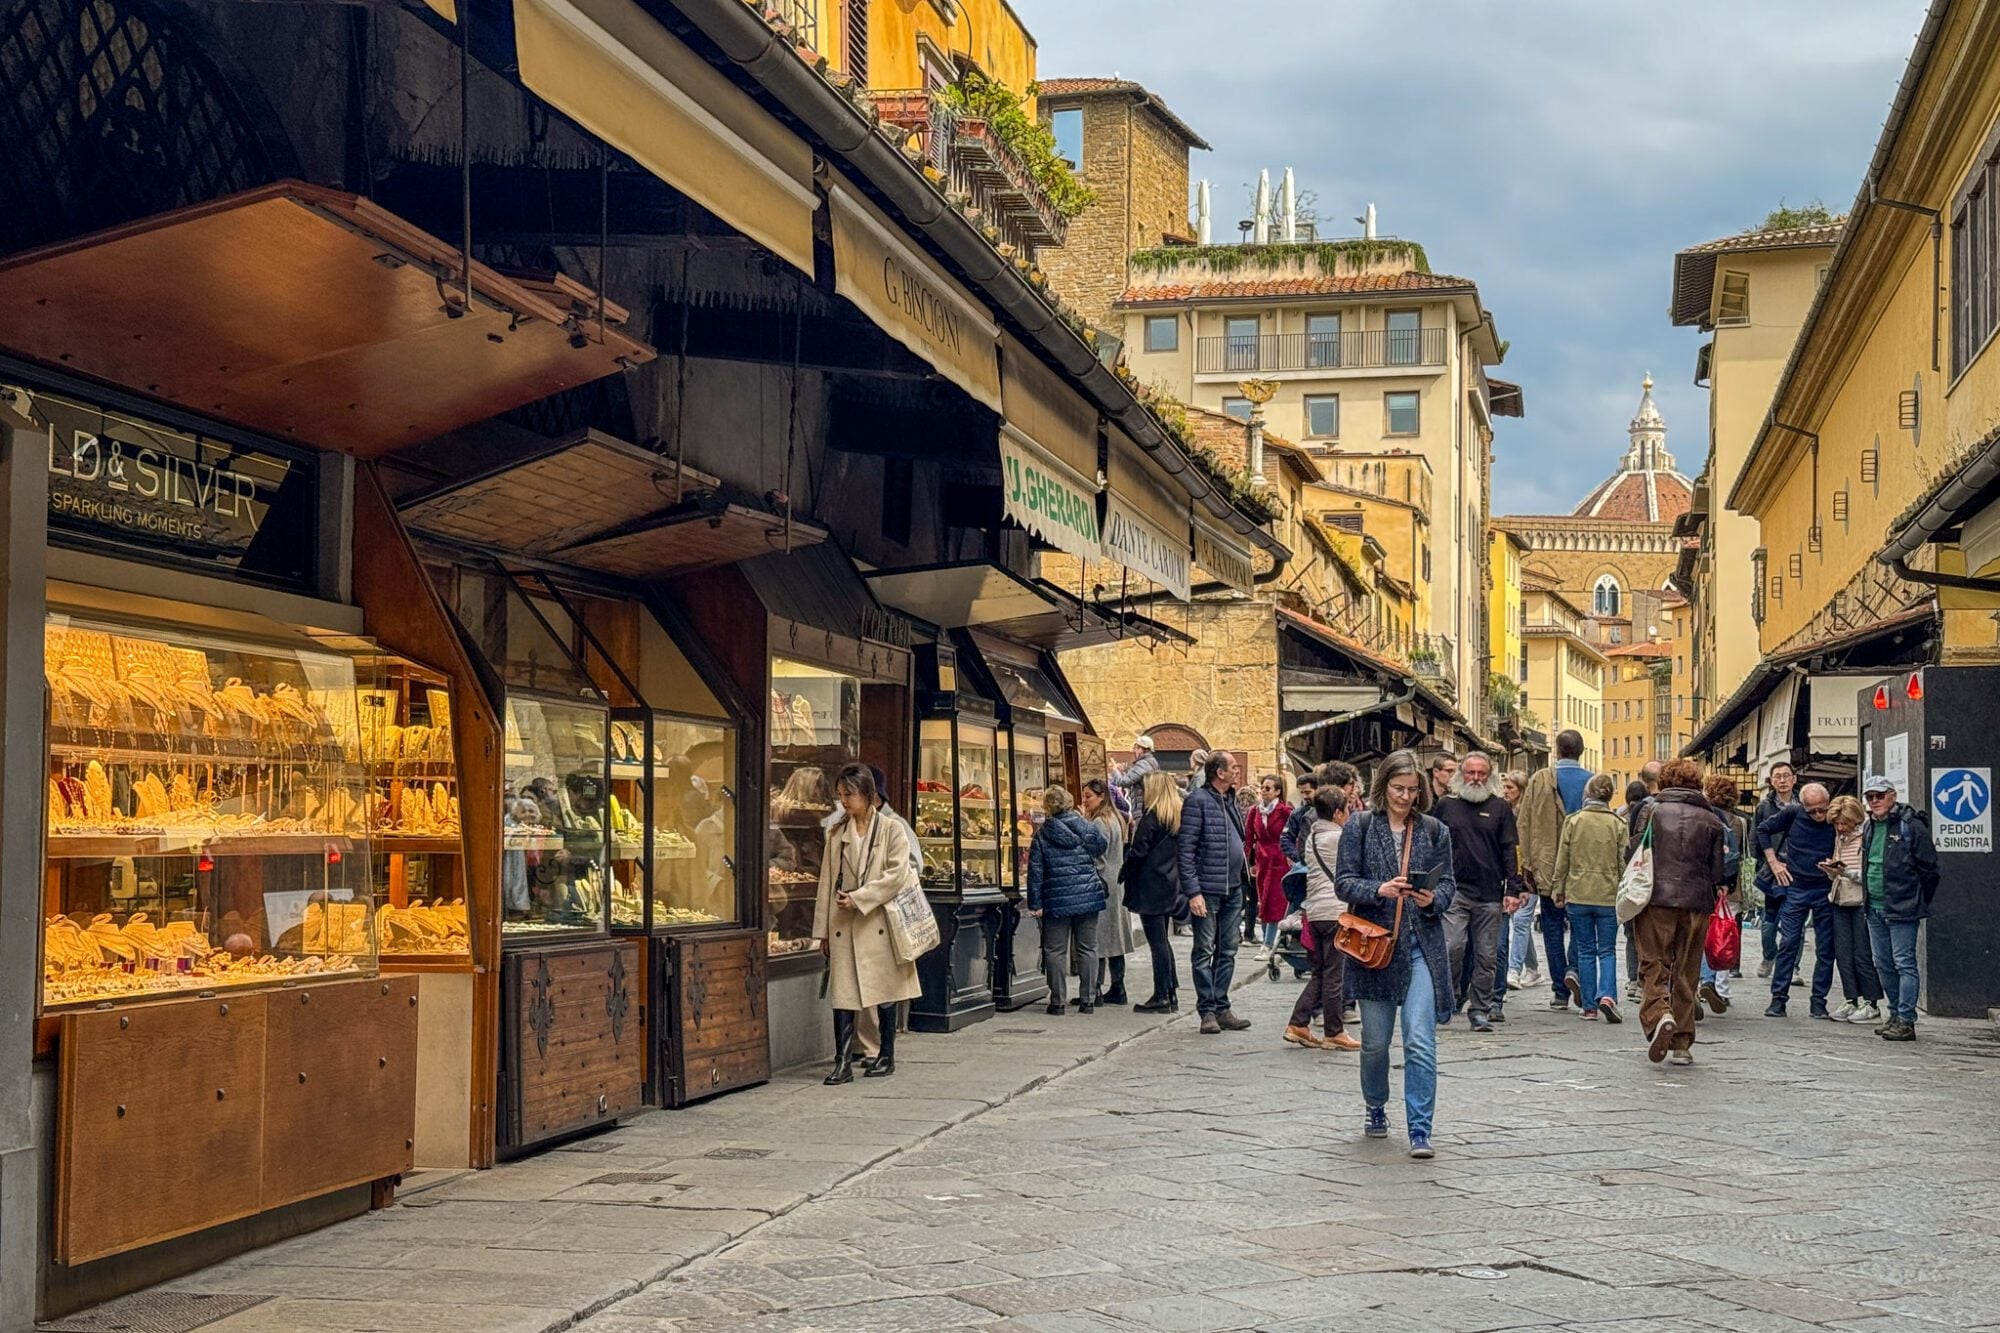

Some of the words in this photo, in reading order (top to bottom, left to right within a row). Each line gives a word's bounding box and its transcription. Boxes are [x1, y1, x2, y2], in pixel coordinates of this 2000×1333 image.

[136, 448, 259, 531] SILVER
[52, 492, 133, 524] SPARKLING
[137, 511, 202, 539] MOMENTS
[1109, 511, 1149, 564] DANTE
[1935, 837, 1941, 848] A
[1944, 837, 1989, 848] SINISTRA
[1940, 824, 1984, 834] PEDONI
